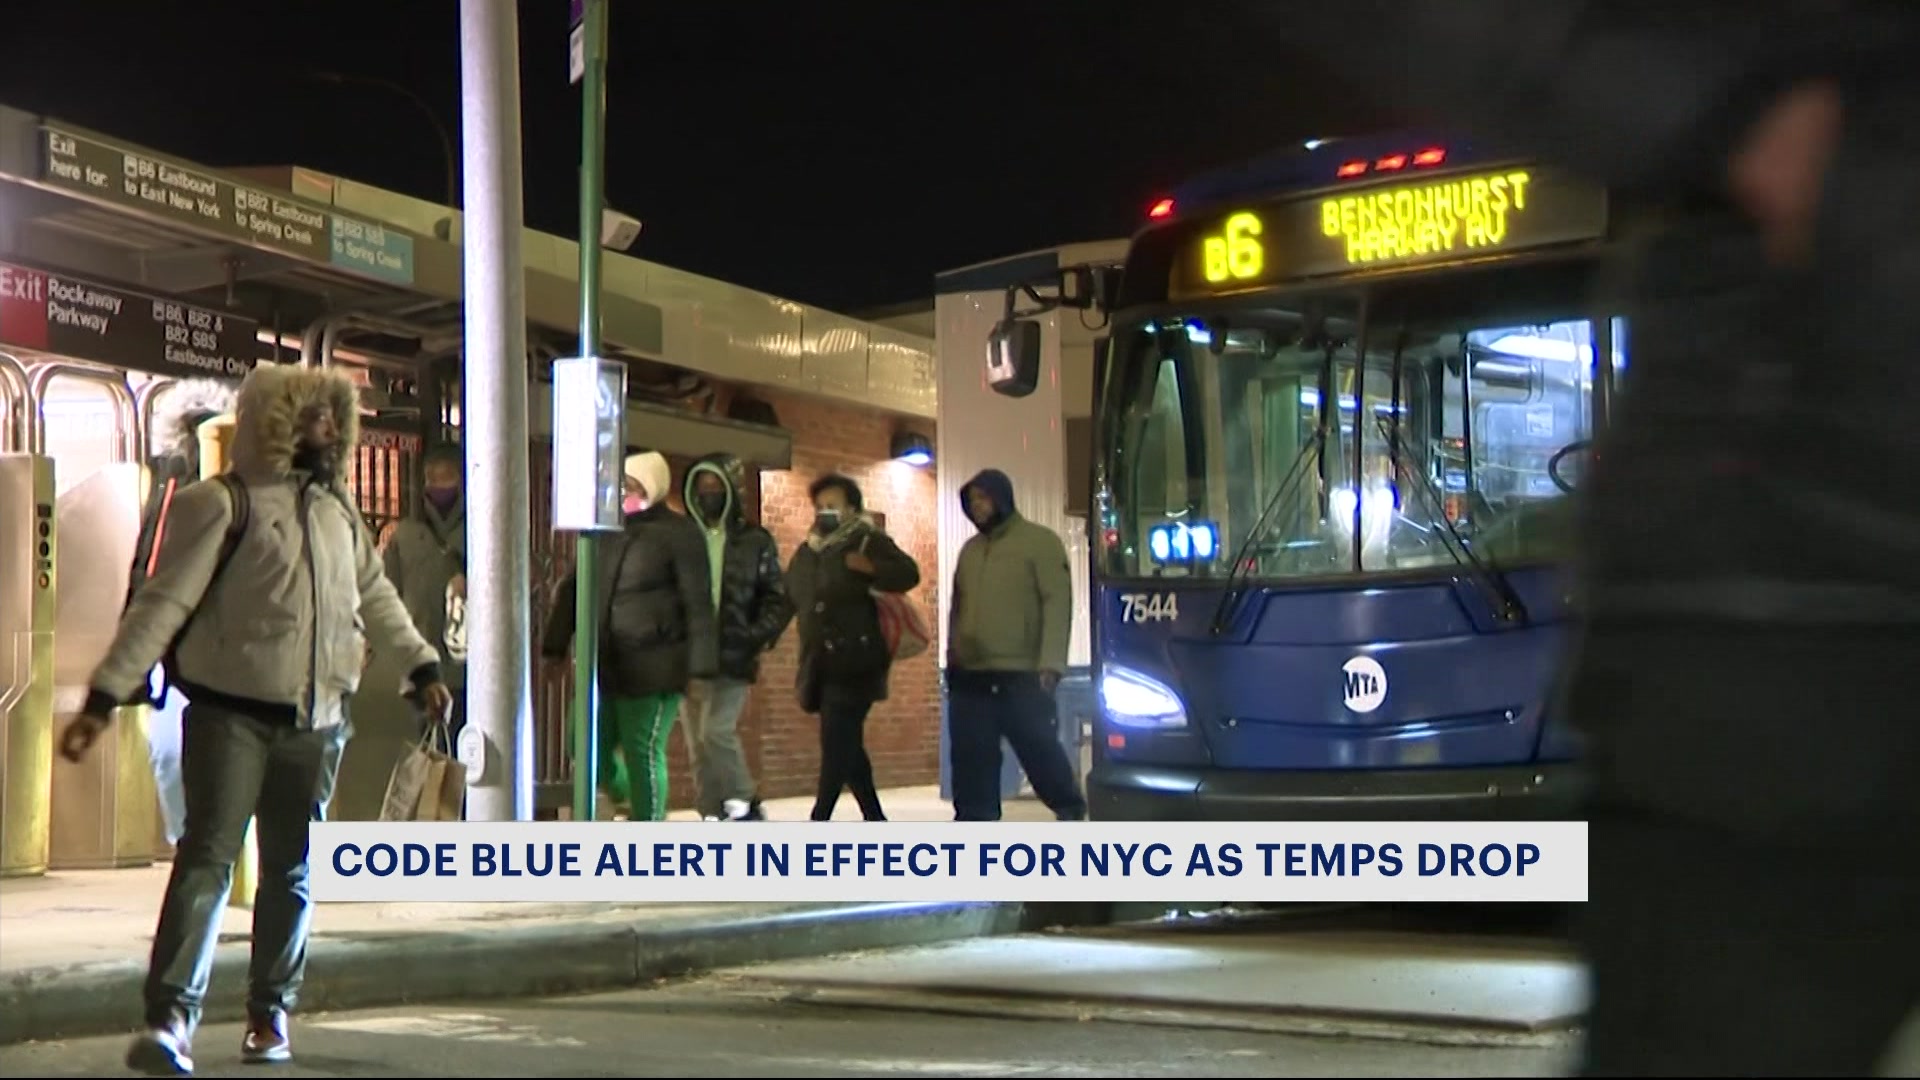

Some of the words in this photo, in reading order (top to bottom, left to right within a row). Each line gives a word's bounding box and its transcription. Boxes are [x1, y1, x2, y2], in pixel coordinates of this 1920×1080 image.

[50, 133, 76, 157] Exit
[50, 154, 81, 180] here
[158, 163, 216, 196] Eastbound
[125, 179, 137, 195] to
[140, 181, 166, 203] East
[169, 191, 194, 210] New
[197, 198, 220, 218] York
[272, 200, 323, 228] Eastbound
[1322, 172, 1529, 236] BENSONHURST
[236, 211, 247, 227] to
[250, 214, 281, 238] Spring
[284, 225, 312, 245] Creek
[1347, 216, 1457, 263] HARWAY
[1465, 203, 1506, 247] AV
[346, 242, 375, 265] Spring
[1204, 213, 1263, 282] B6
[0, 268, 41, 300] Exit
[48, 278, 122, 314] Rockaway
[48, 303, 109, 334] Parkway
[189, 309, 211, 329] B82
[166, 324, 188, 344] B82
[193, 330, 217, 350] SBS
[165, 345, 223, 370] Eastbound
[1121, 592, 1179, 624] 7544
[1343, 670, 1379, 701] MTA
